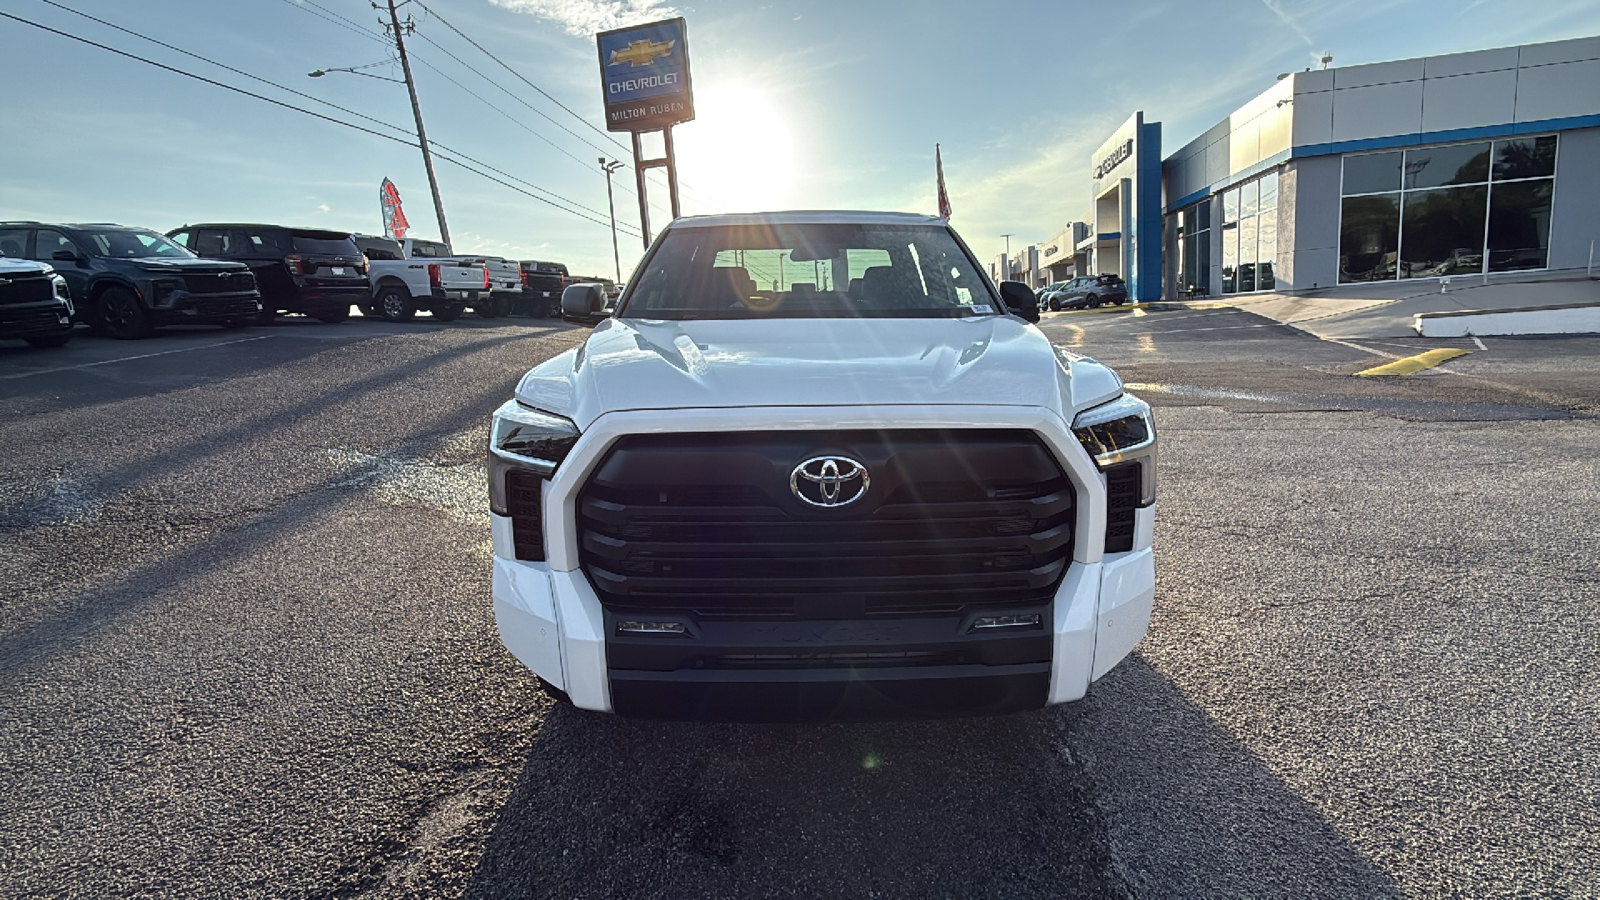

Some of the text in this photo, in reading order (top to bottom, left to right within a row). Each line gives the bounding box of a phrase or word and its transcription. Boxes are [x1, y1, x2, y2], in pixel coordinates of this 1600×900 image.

[609, 72, 678, 94] CHEVROLET
[611, 102, 684, 121] MILTON RUBEN
